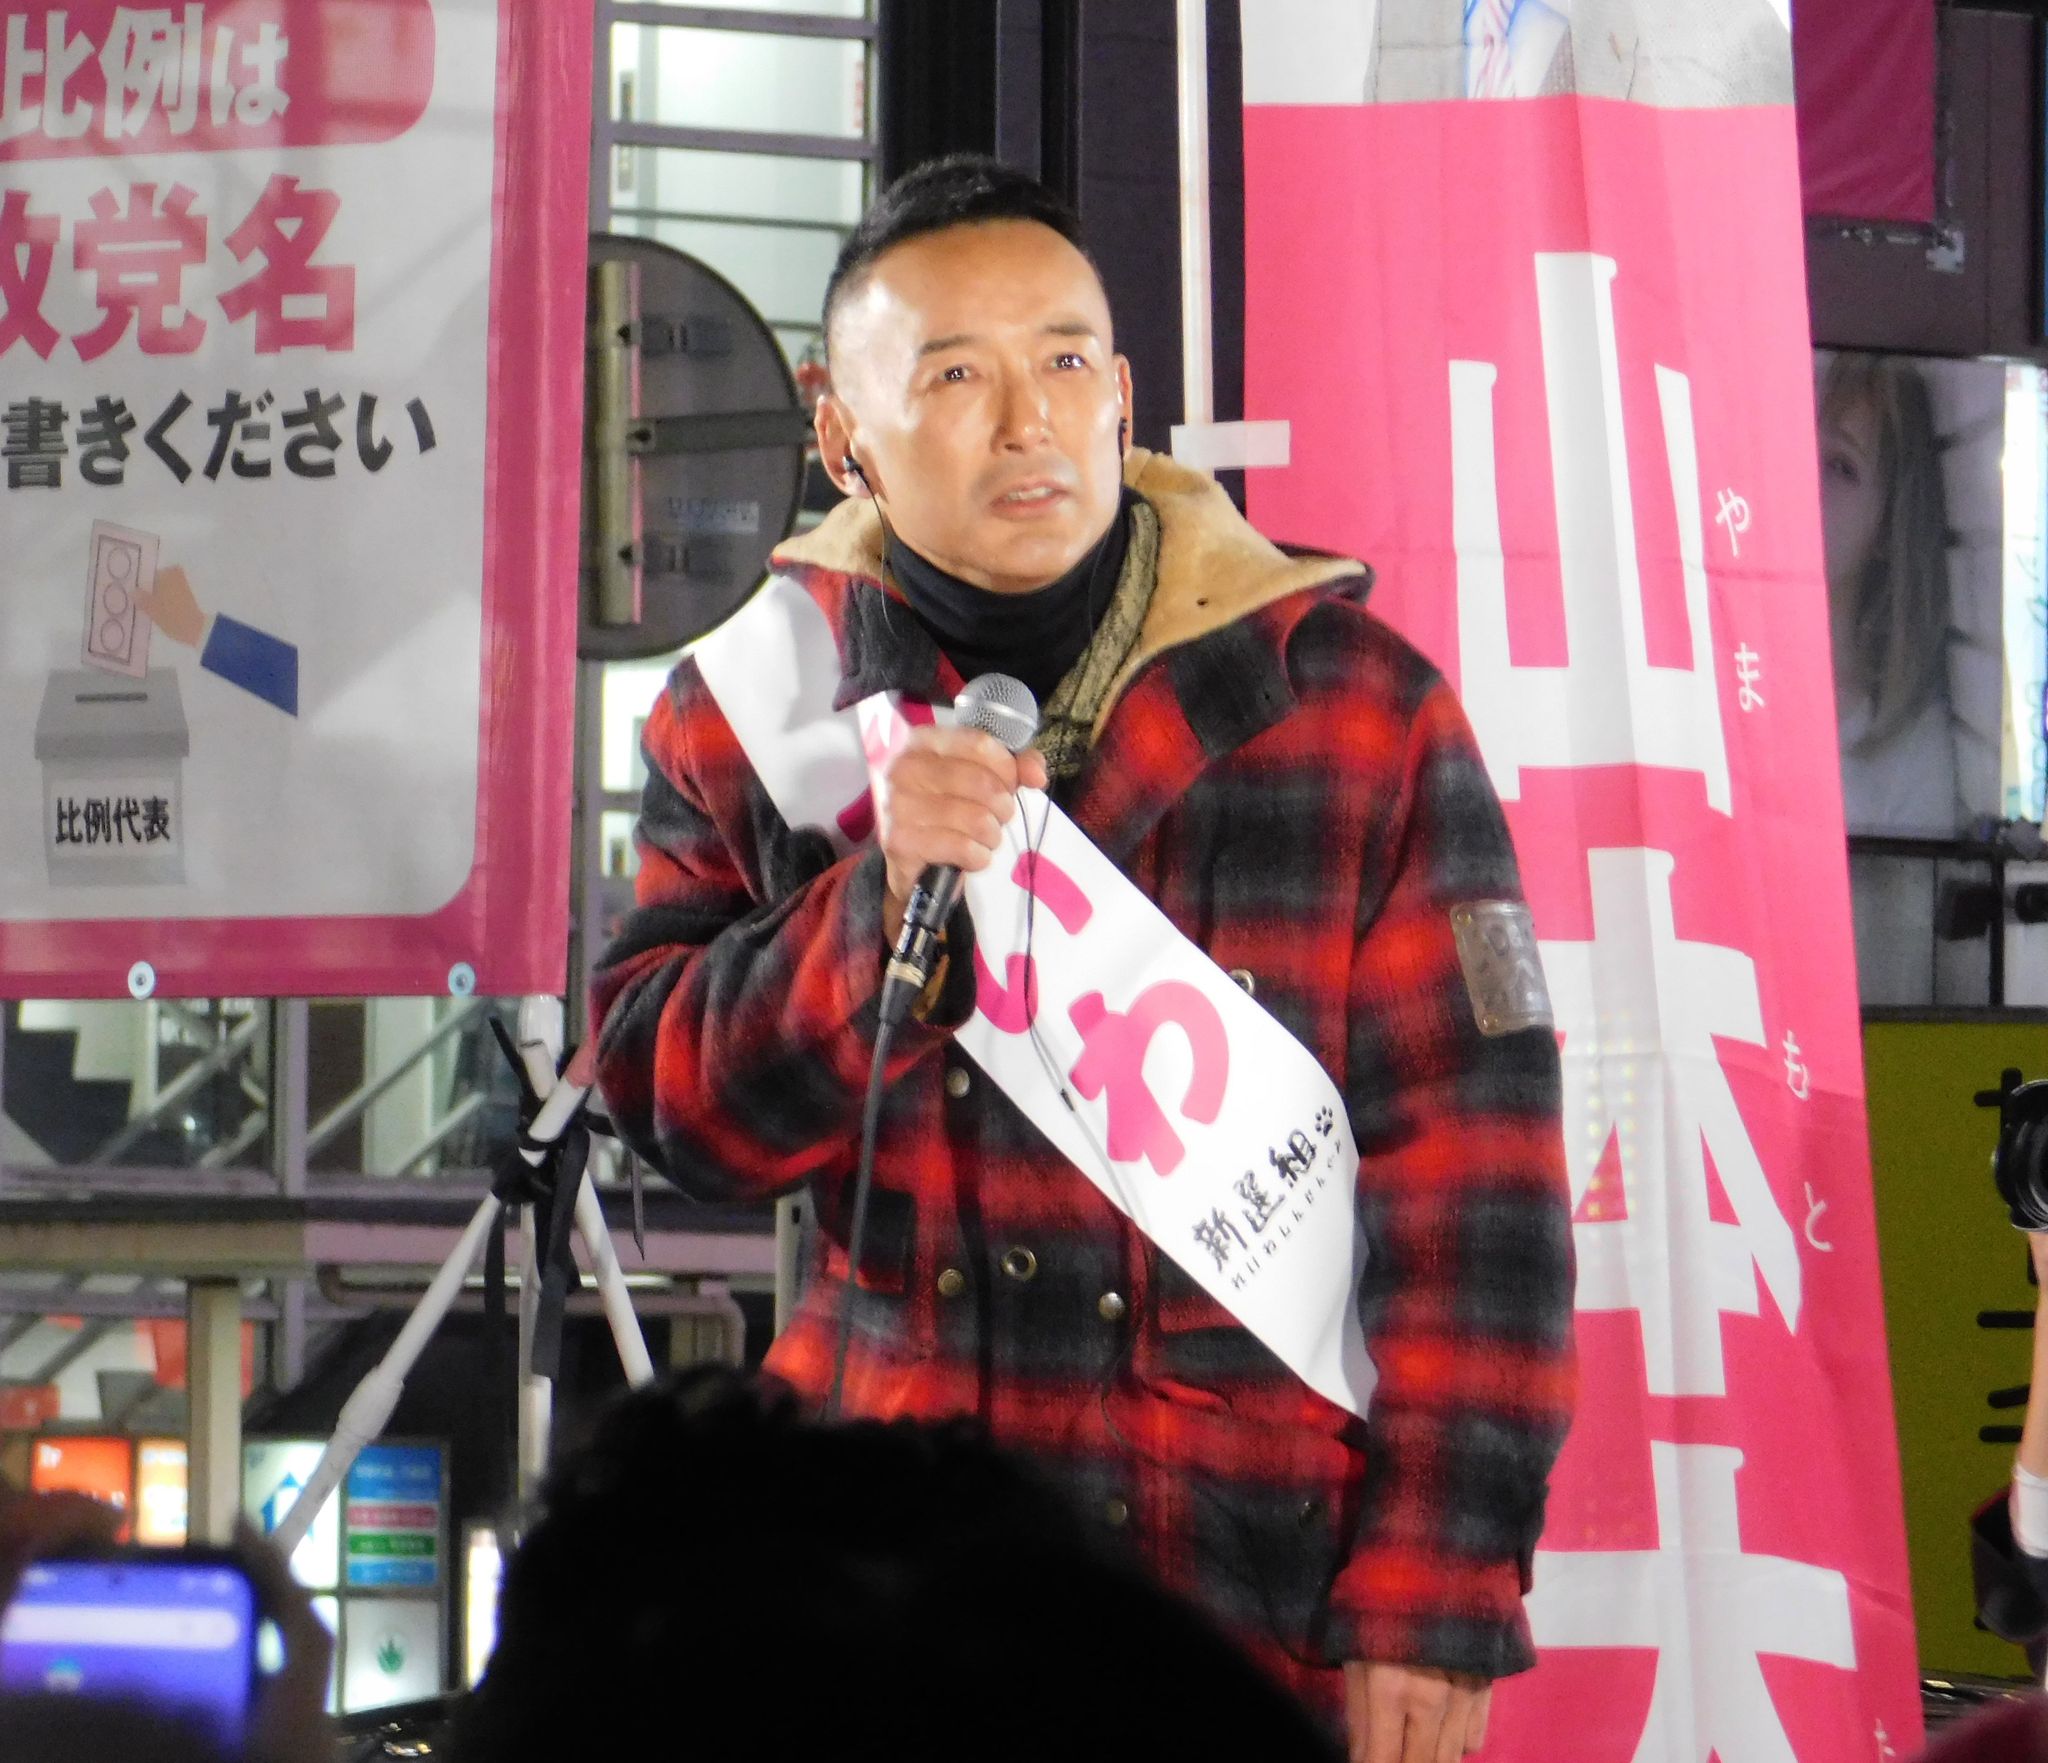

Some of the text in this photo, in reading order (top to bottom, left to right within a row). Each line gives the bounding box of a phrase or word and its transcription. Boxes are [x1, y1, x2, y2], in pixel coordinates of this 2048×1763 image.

[0, 3, 290, 140] 比例は
[0, 388, 437, 489] 書きください
[55, 796, 171, 844] 比例代表
